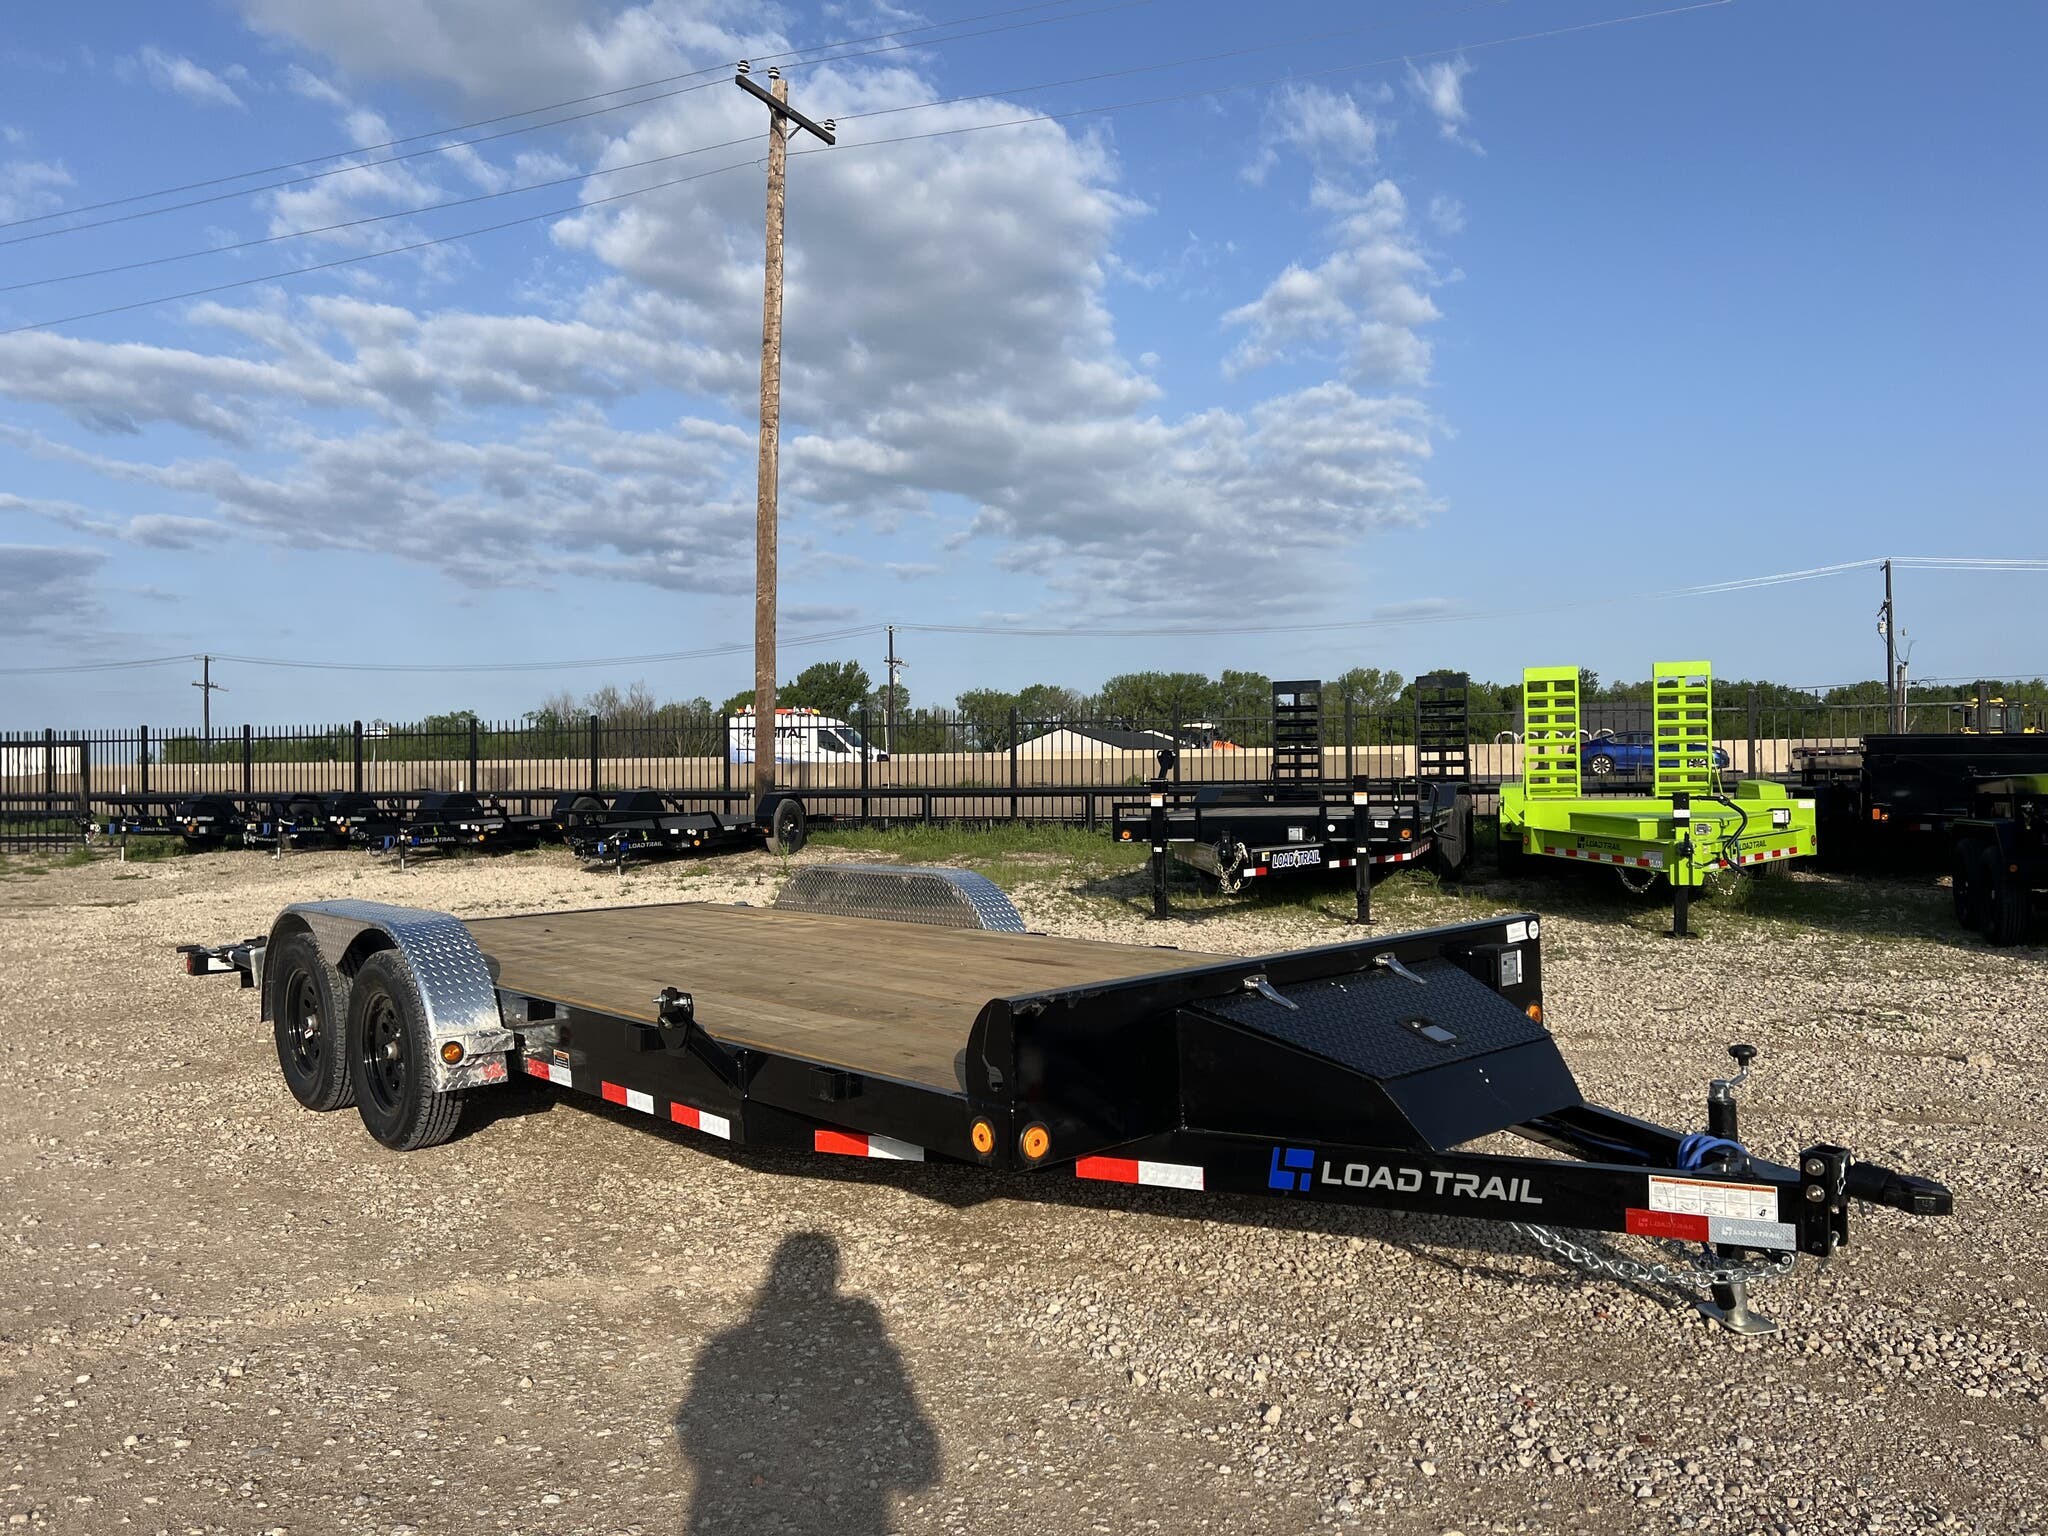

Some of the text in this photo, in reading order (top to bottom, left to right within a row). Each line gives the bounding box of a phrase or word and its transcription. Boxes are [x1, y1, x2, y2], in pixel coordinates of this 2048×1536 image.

[1273, 850, 1320, 868] LOAD TRAIL
[1321, 1160, 1422, 1193] LOAD
[1430, 1170, 1543, 1204] TRAIL
